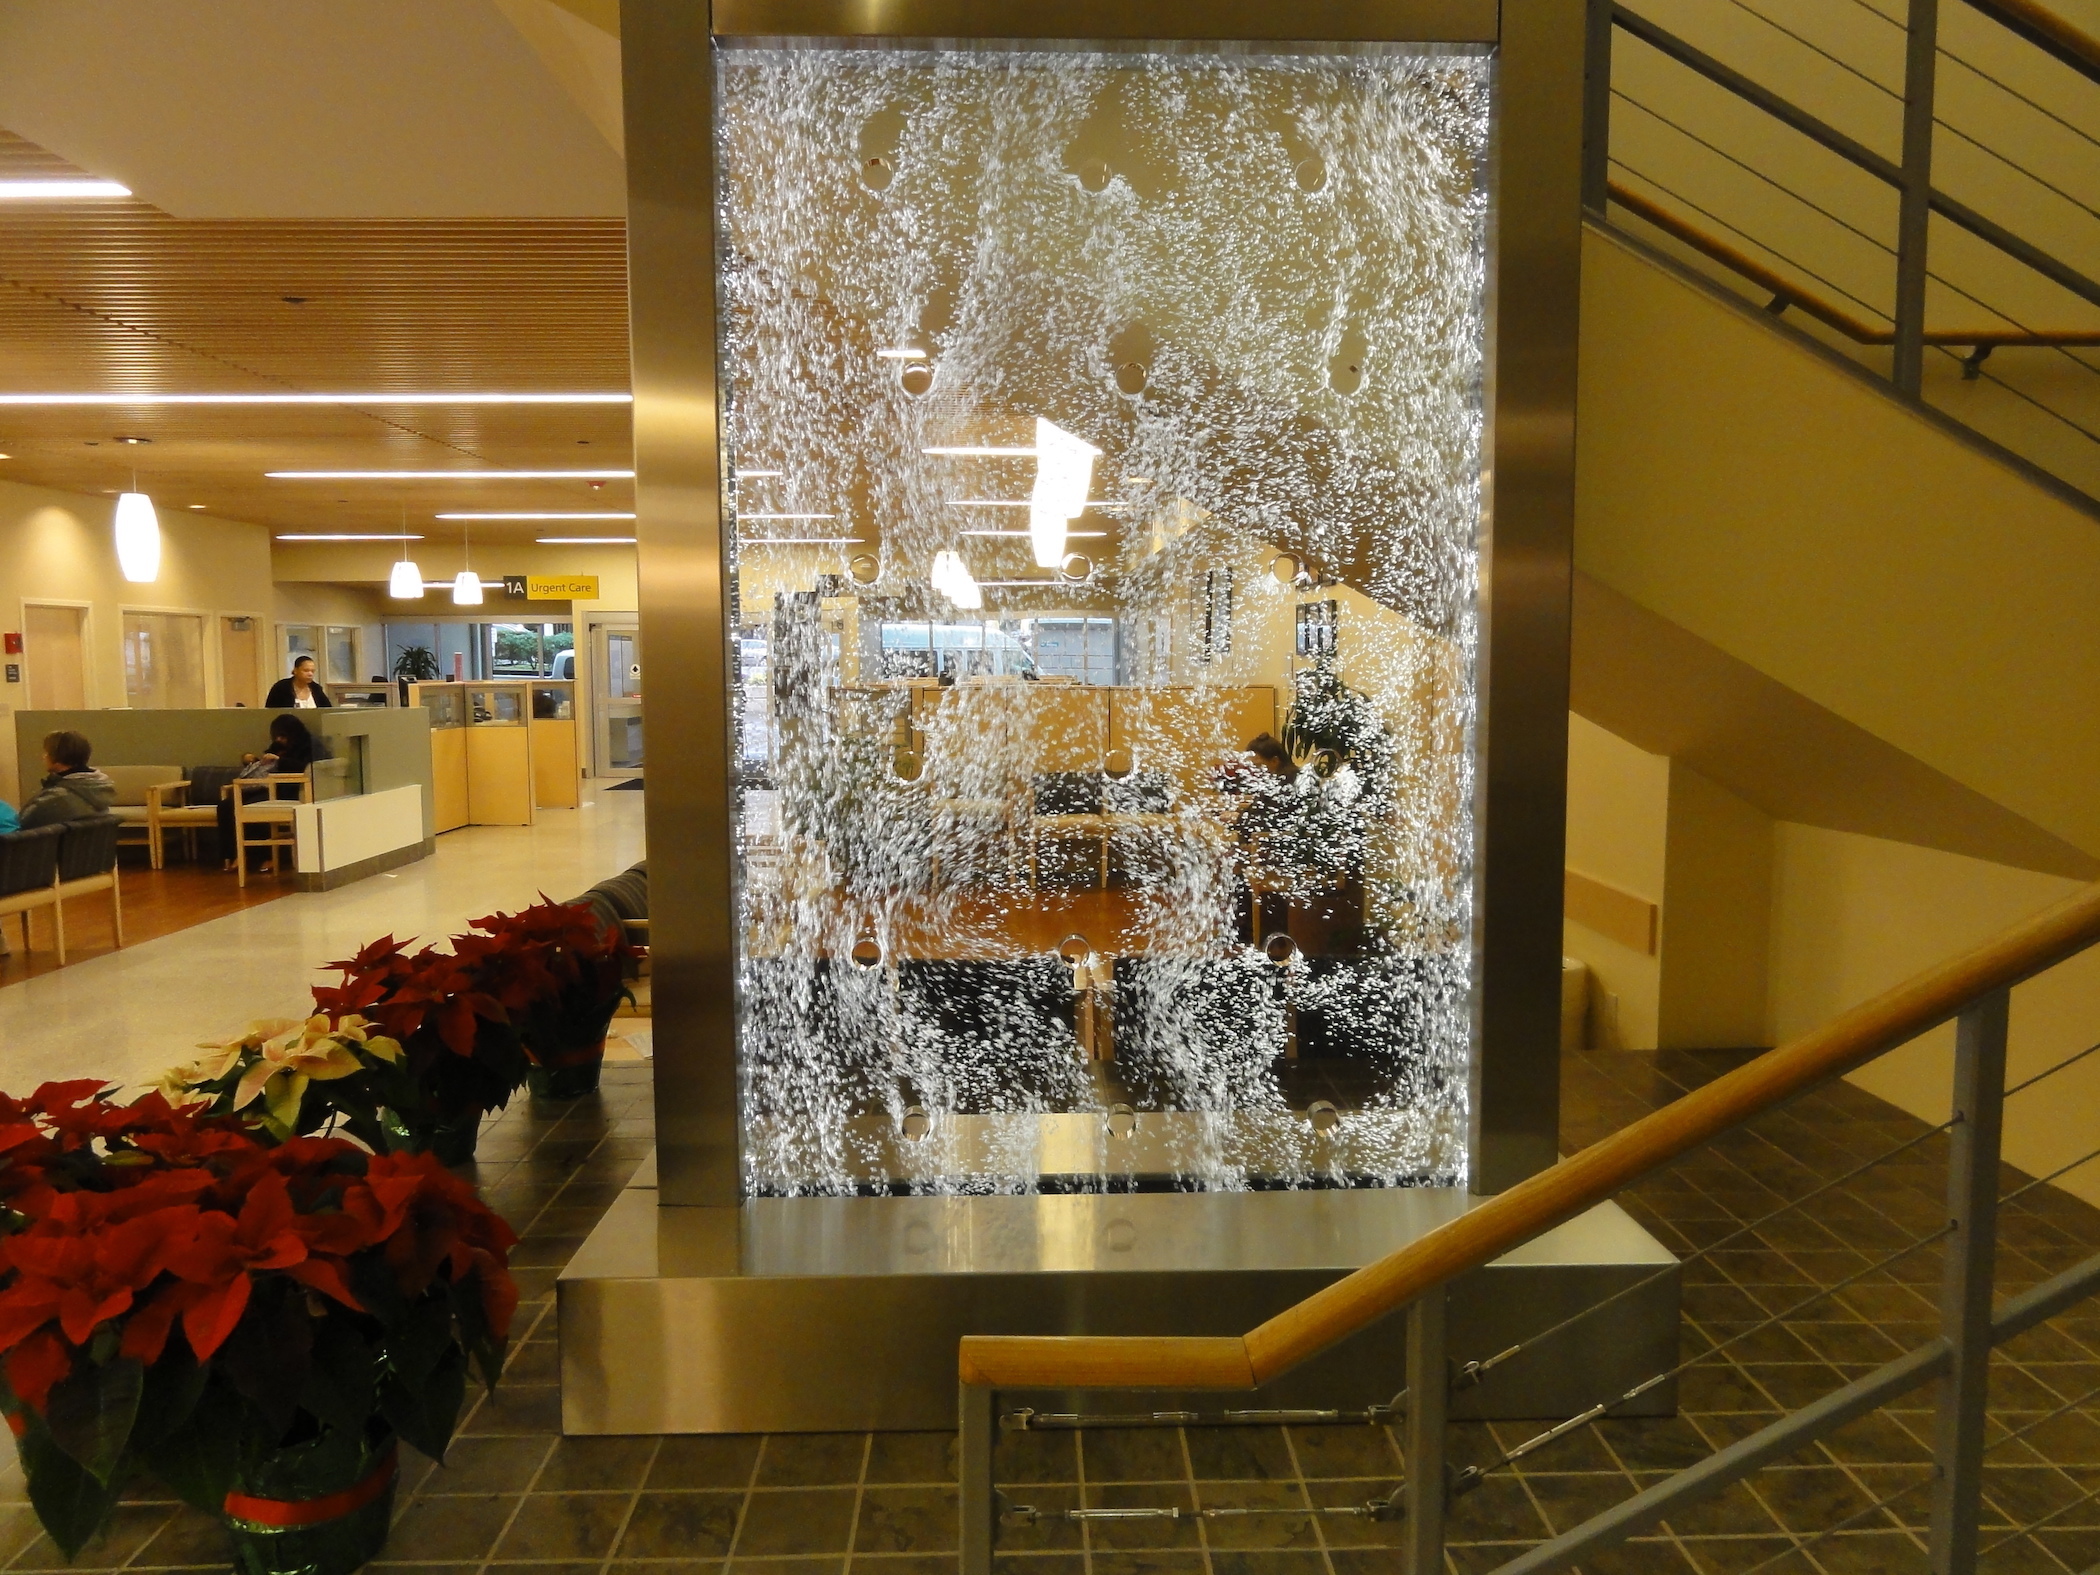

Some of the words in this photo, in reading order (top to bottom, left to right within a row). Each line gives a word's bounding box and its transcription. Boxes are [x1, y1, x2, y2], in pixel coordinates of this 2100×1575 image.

[506, 582, 524, 594] 1A
[531, 583, 566, 594] Urgent
[568, 583, 592, 593] Care
